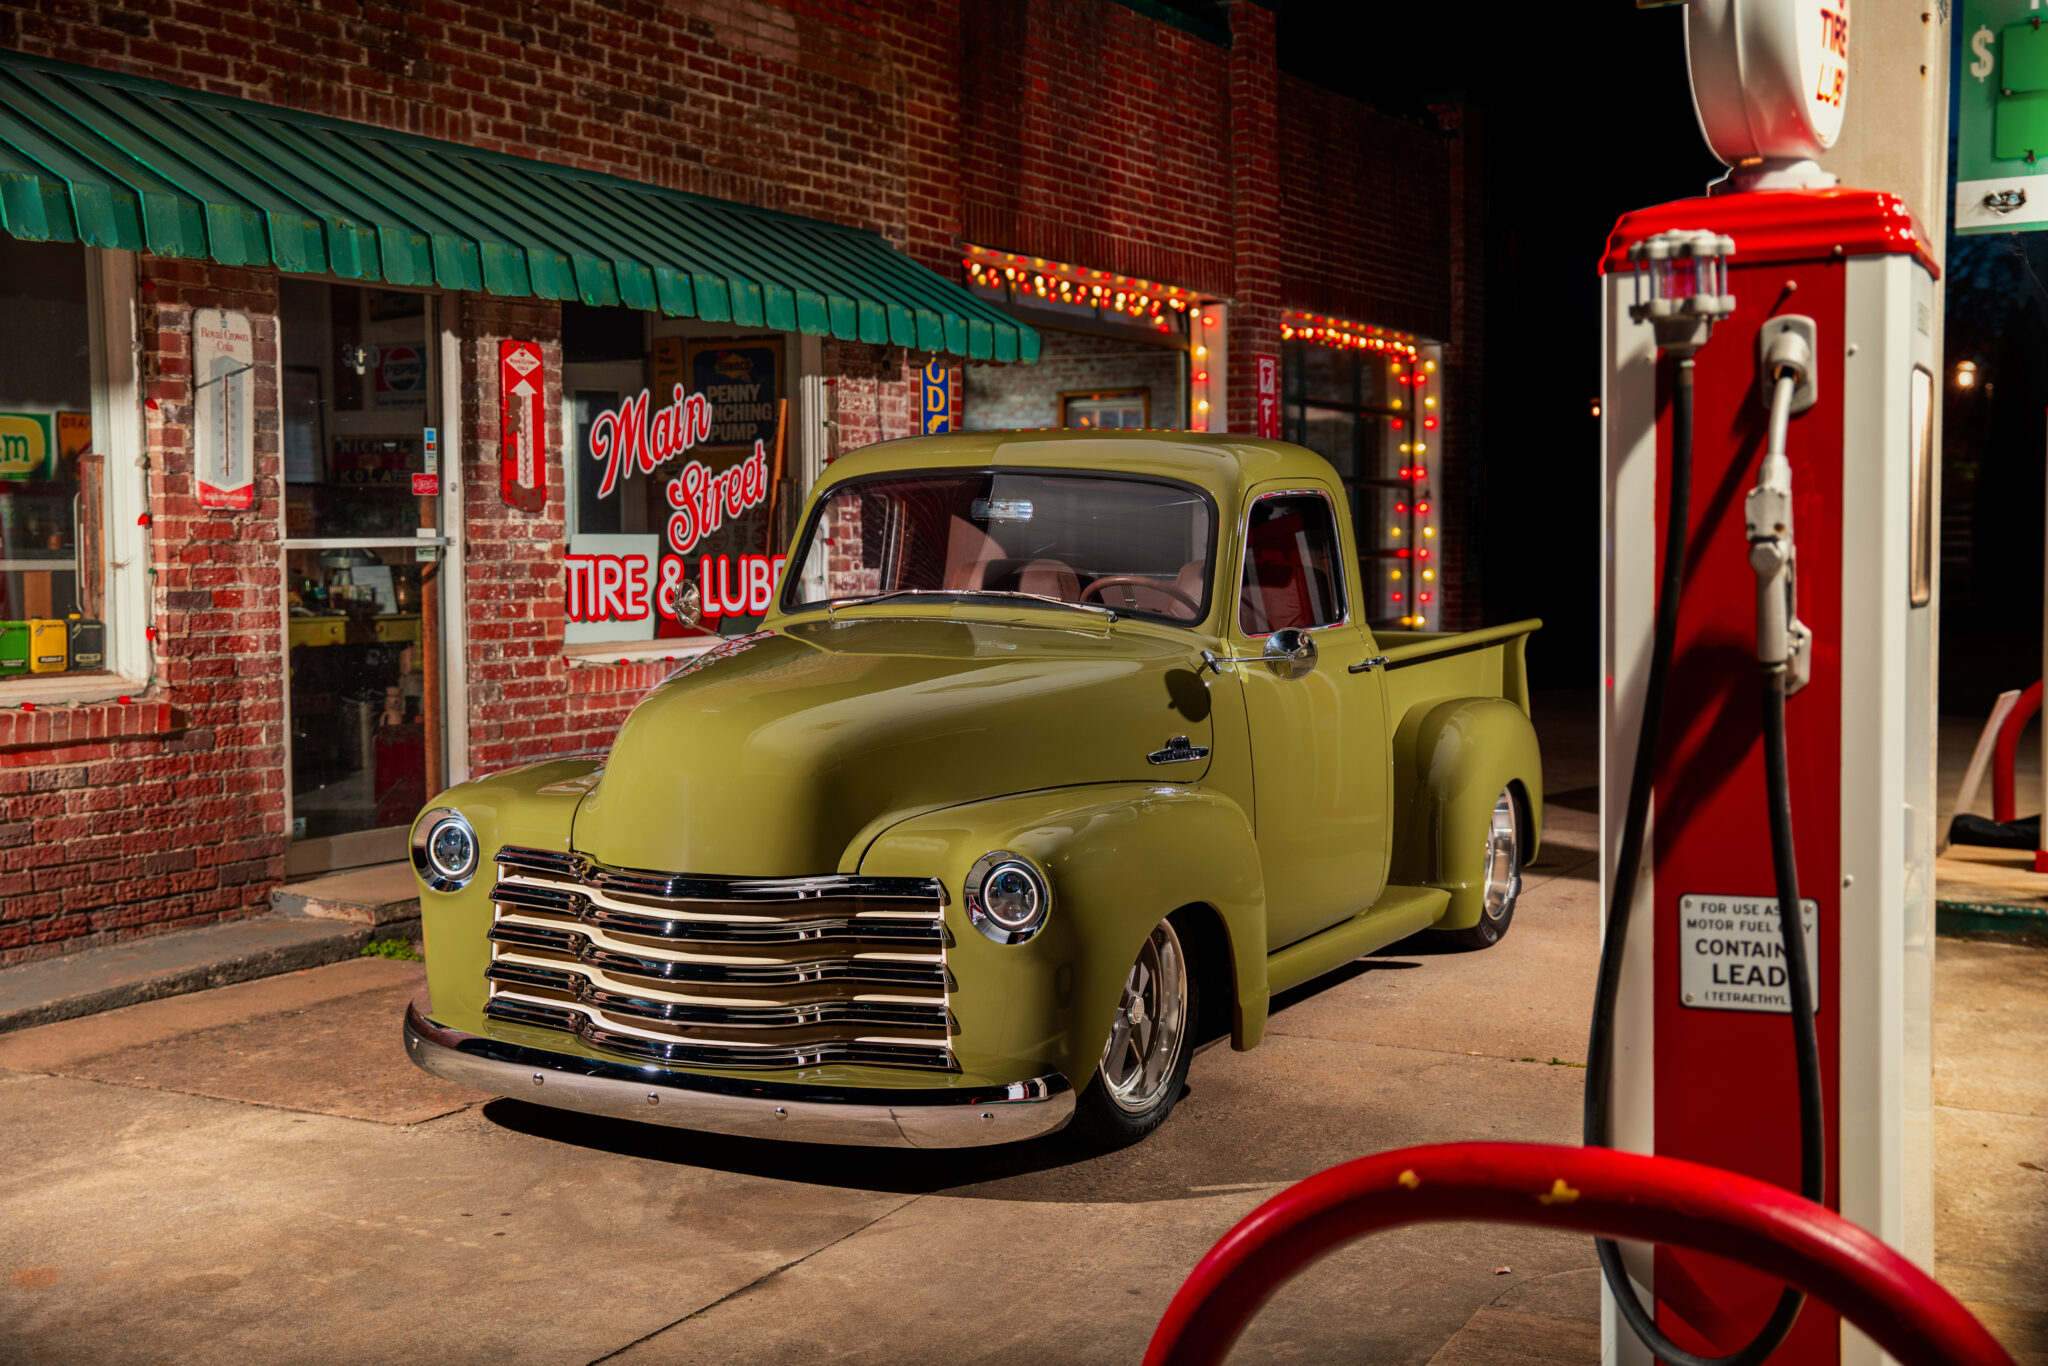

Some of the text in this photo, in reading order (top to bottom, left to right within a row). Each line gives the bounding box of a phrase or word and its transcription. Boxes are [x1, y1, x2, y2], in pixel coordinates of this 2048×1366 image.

[1969, 24, 1995, 83] $
[201, 326, 249, 342] Royal Crown
[216, 340, 234, 353] Cola
[384, 363, 420, 377] PEPSI
[706, 383, 761, 403] PENNY
[711, 402, 773, 421] NCHING
[590, 382, 712, 499] Main
[709, 422, 758, 442] PUMP
[666, 438, 769, 554] Street
[565, 554, 649, 621] TIRE
[656, 554, 686, 619] &
[1701, 902, 1782, 917] FOR USE AS
[1687, 918, 1734, 931] MOTOR
[1739, 920, 1773, 933] FUEL
[1695, 938, 1787, 959] CONTAIN
[1712, 963, 1788, 988] LEAD
[1704, 990, 1790, 1006] (TETRAETHYL
